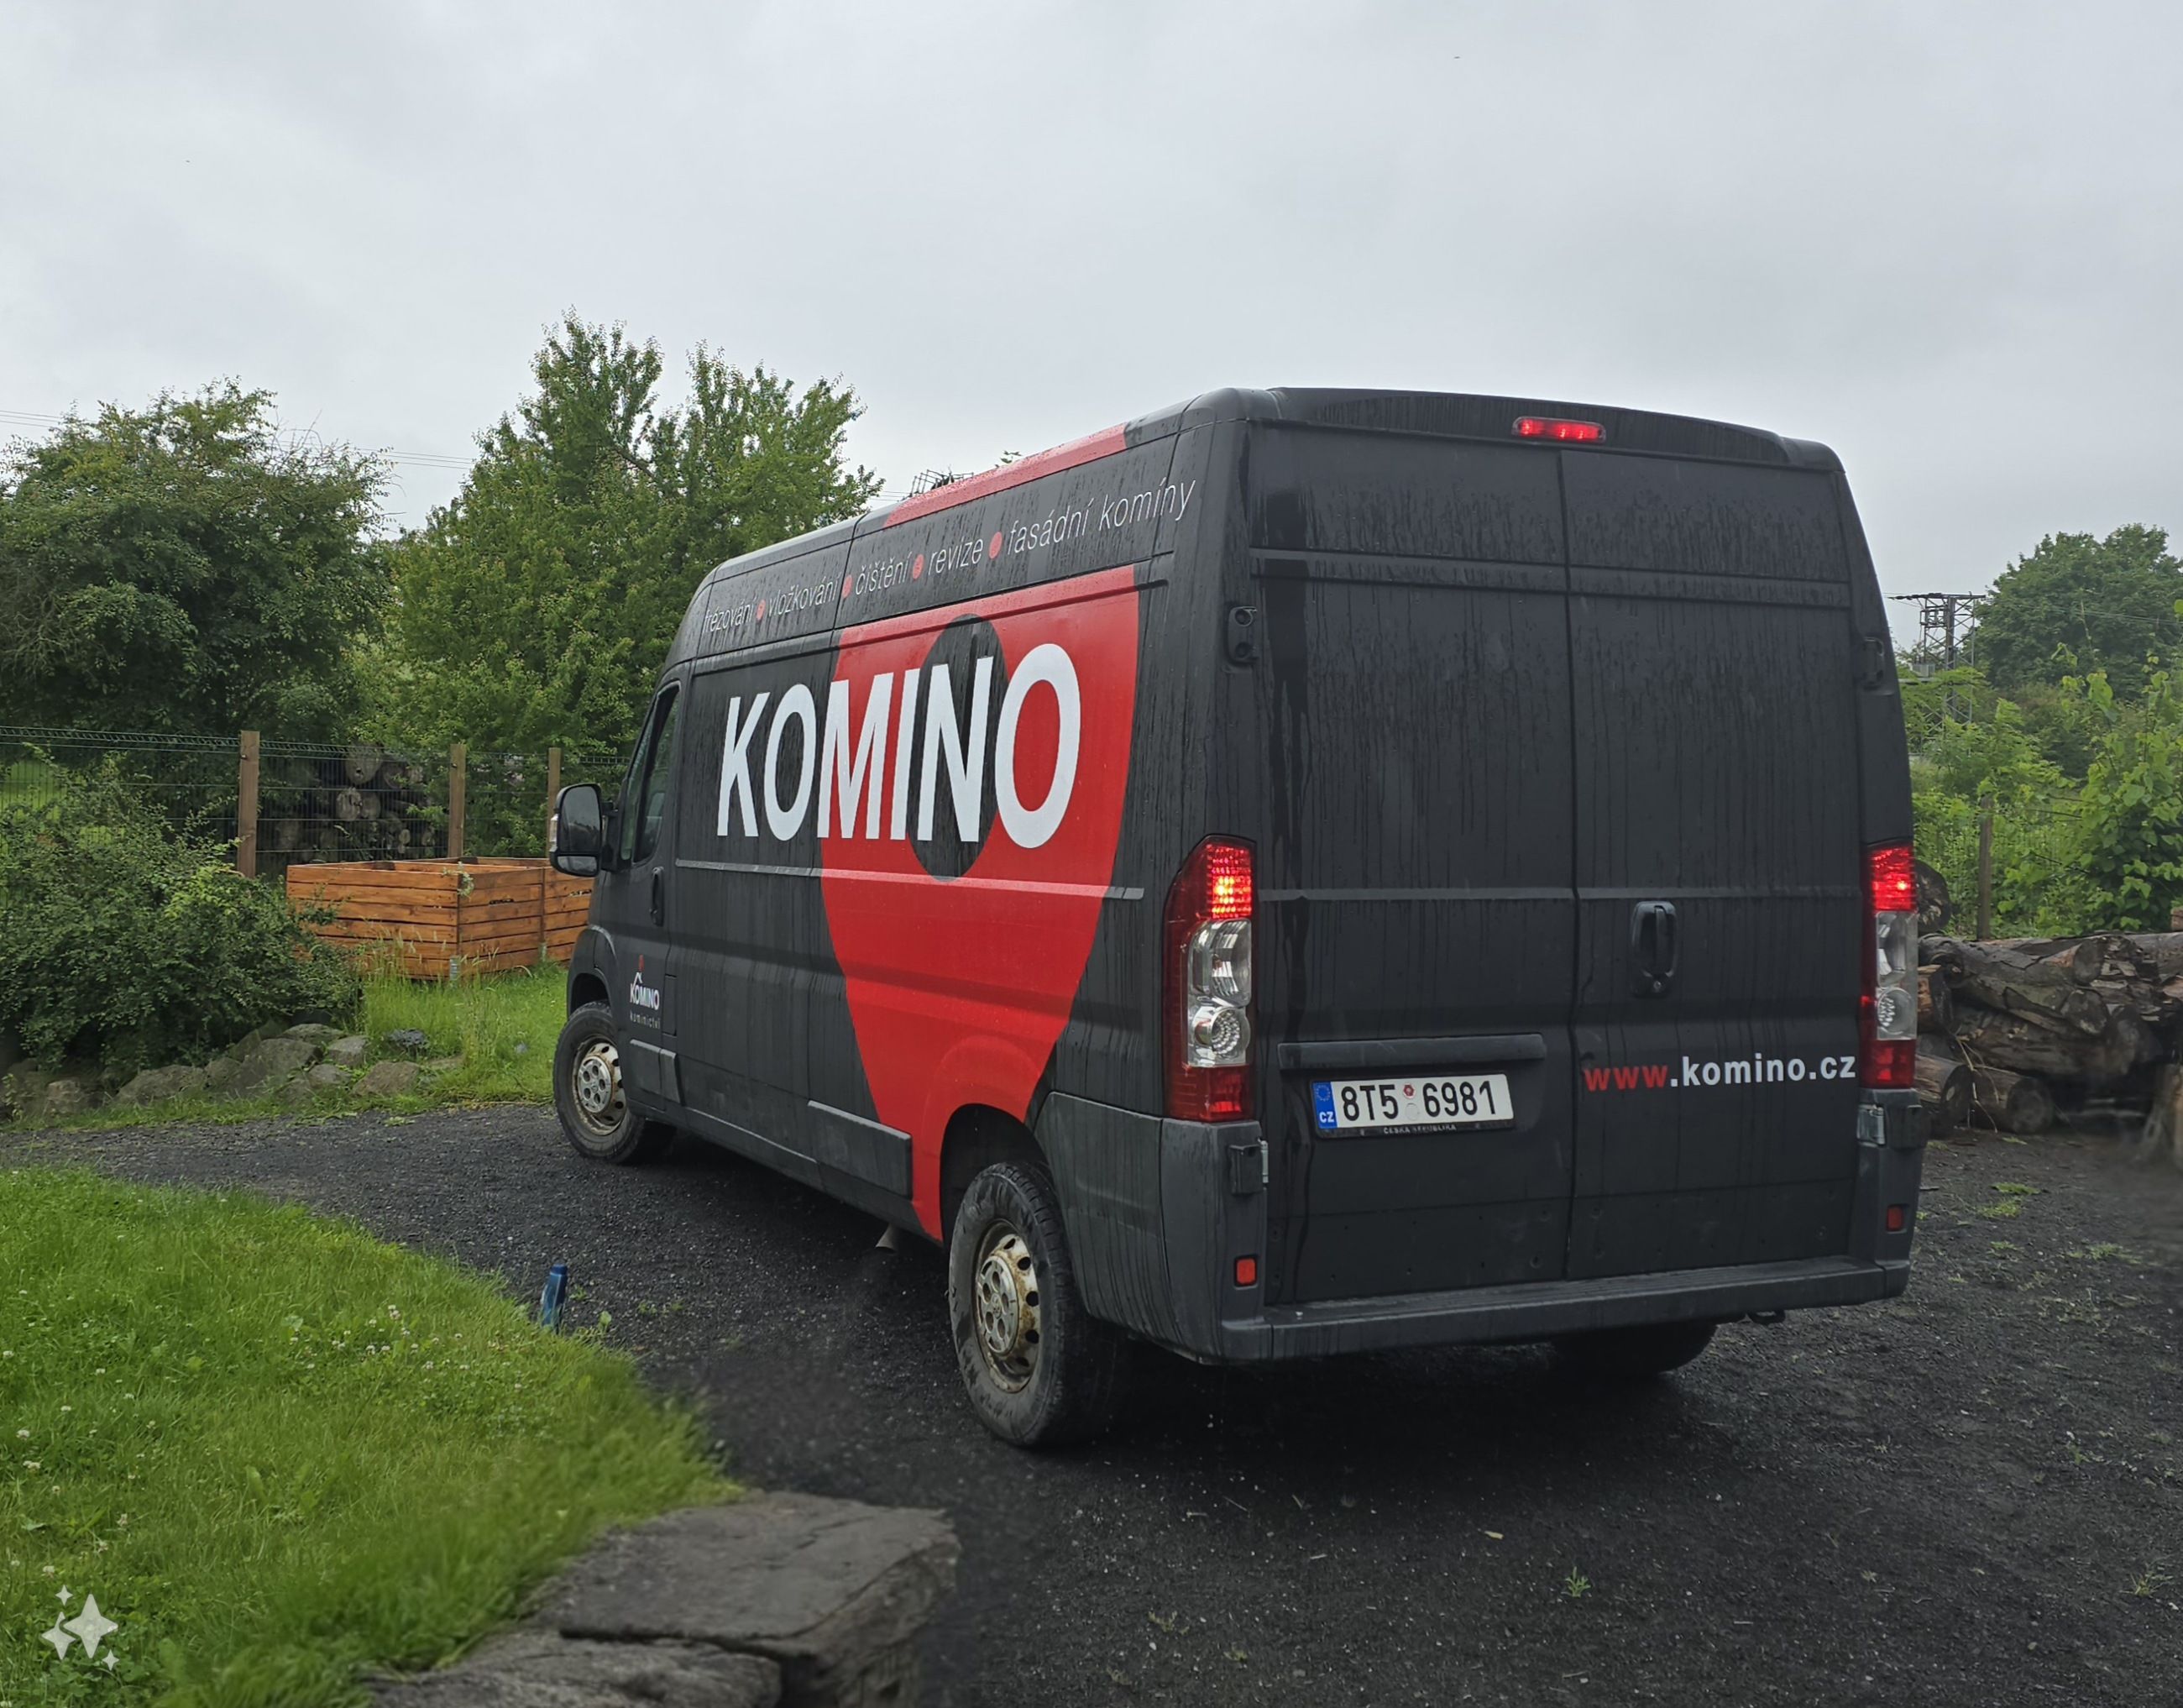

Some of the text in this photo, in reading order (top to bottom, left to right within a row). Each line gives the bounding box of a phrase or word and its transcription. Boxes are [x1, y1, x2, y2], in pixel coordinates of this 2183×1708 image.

[701, 476, 1196, 634] frézování vložkování čištění revize fasádní komíny
[717, 643, 1081, 848] KOMINO
[630, 972, 660, 1011] KOMINO
[1584, 1053, 1856, 1092] www.komino.cz
[1319, 1111, 1335, 1123] CZ
[1341, 1081, 1496, 1122] 8T5 6981
